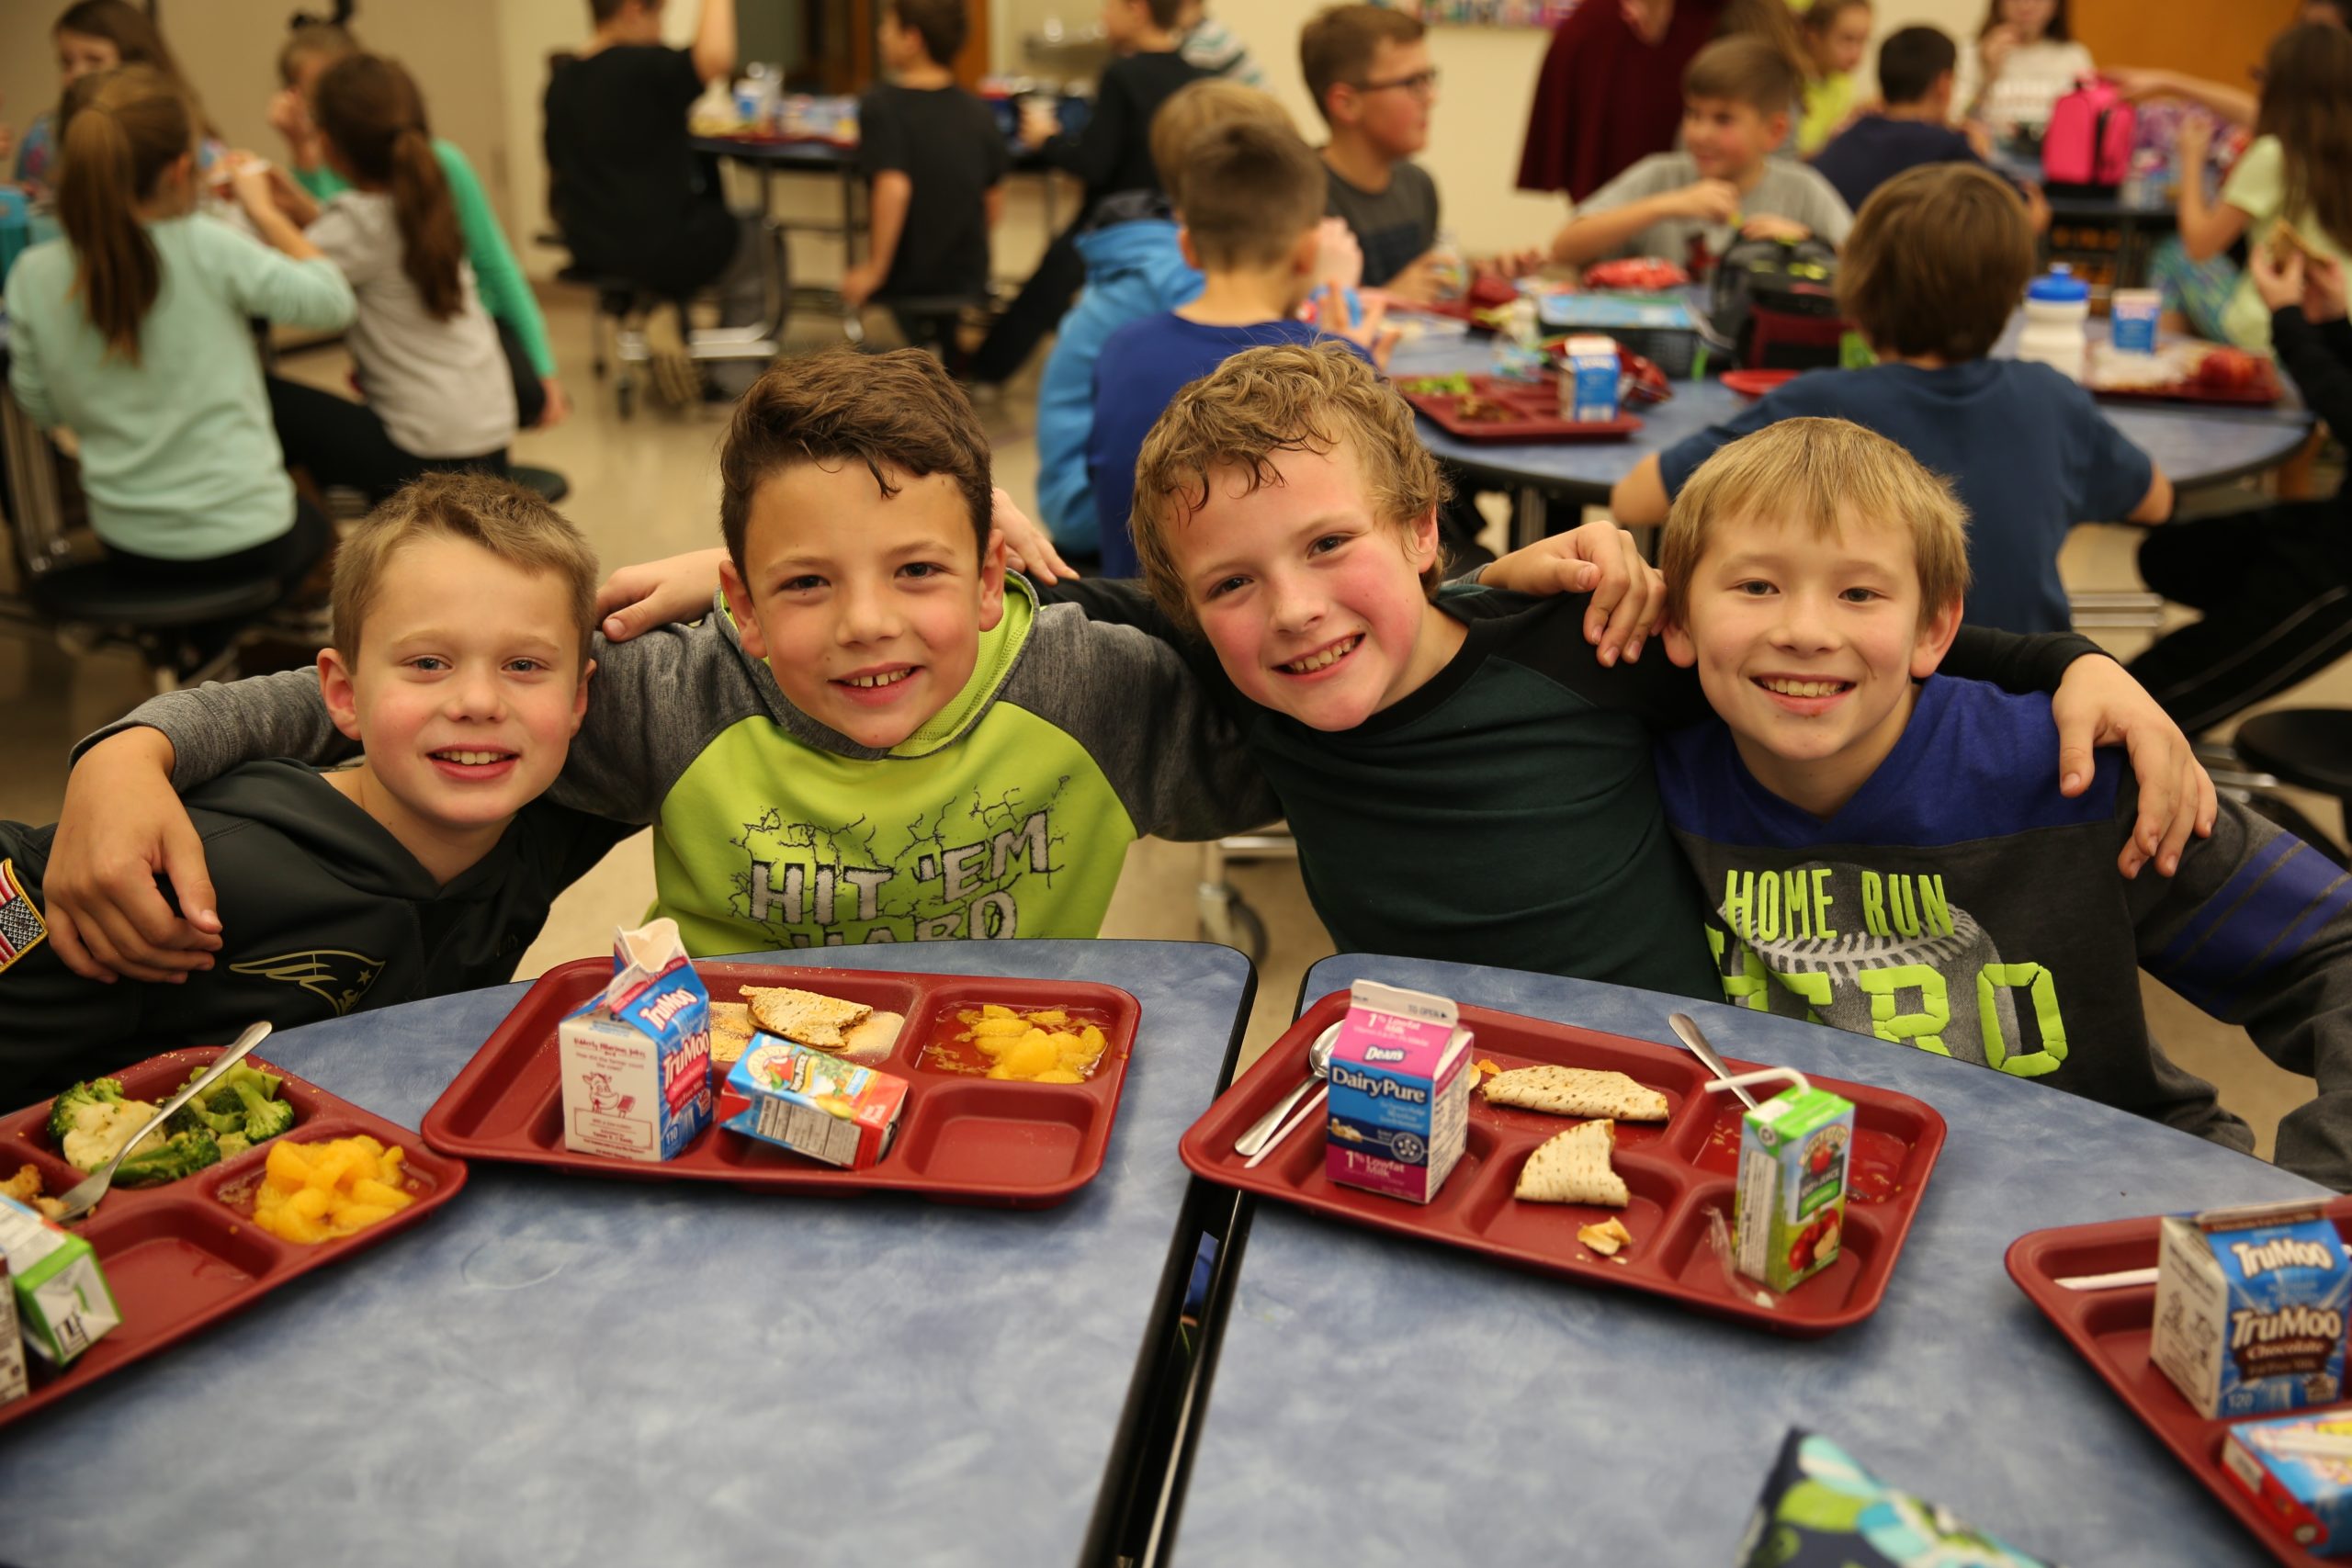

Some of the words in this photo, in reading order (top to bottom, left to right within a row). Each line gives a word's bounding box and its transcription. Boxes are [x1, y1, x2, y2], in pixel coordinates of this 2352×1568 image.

[750, 860, 894, 924] HIT
[918, 809, 1049, 904] 'EM
[1725, 868, 1838, 942] HOME
[1861, 870, 1955, 937] RUN
[639, 987, 698, 1032] TruMoo
[663, 1031, 709, 1090] TruMoo
[1332, 1067, 1426, 1103] DairyPure
[2231, 1237, 2334, 1279] TruMoo
[2231, 1304, 2343, 1349] TruMoo
